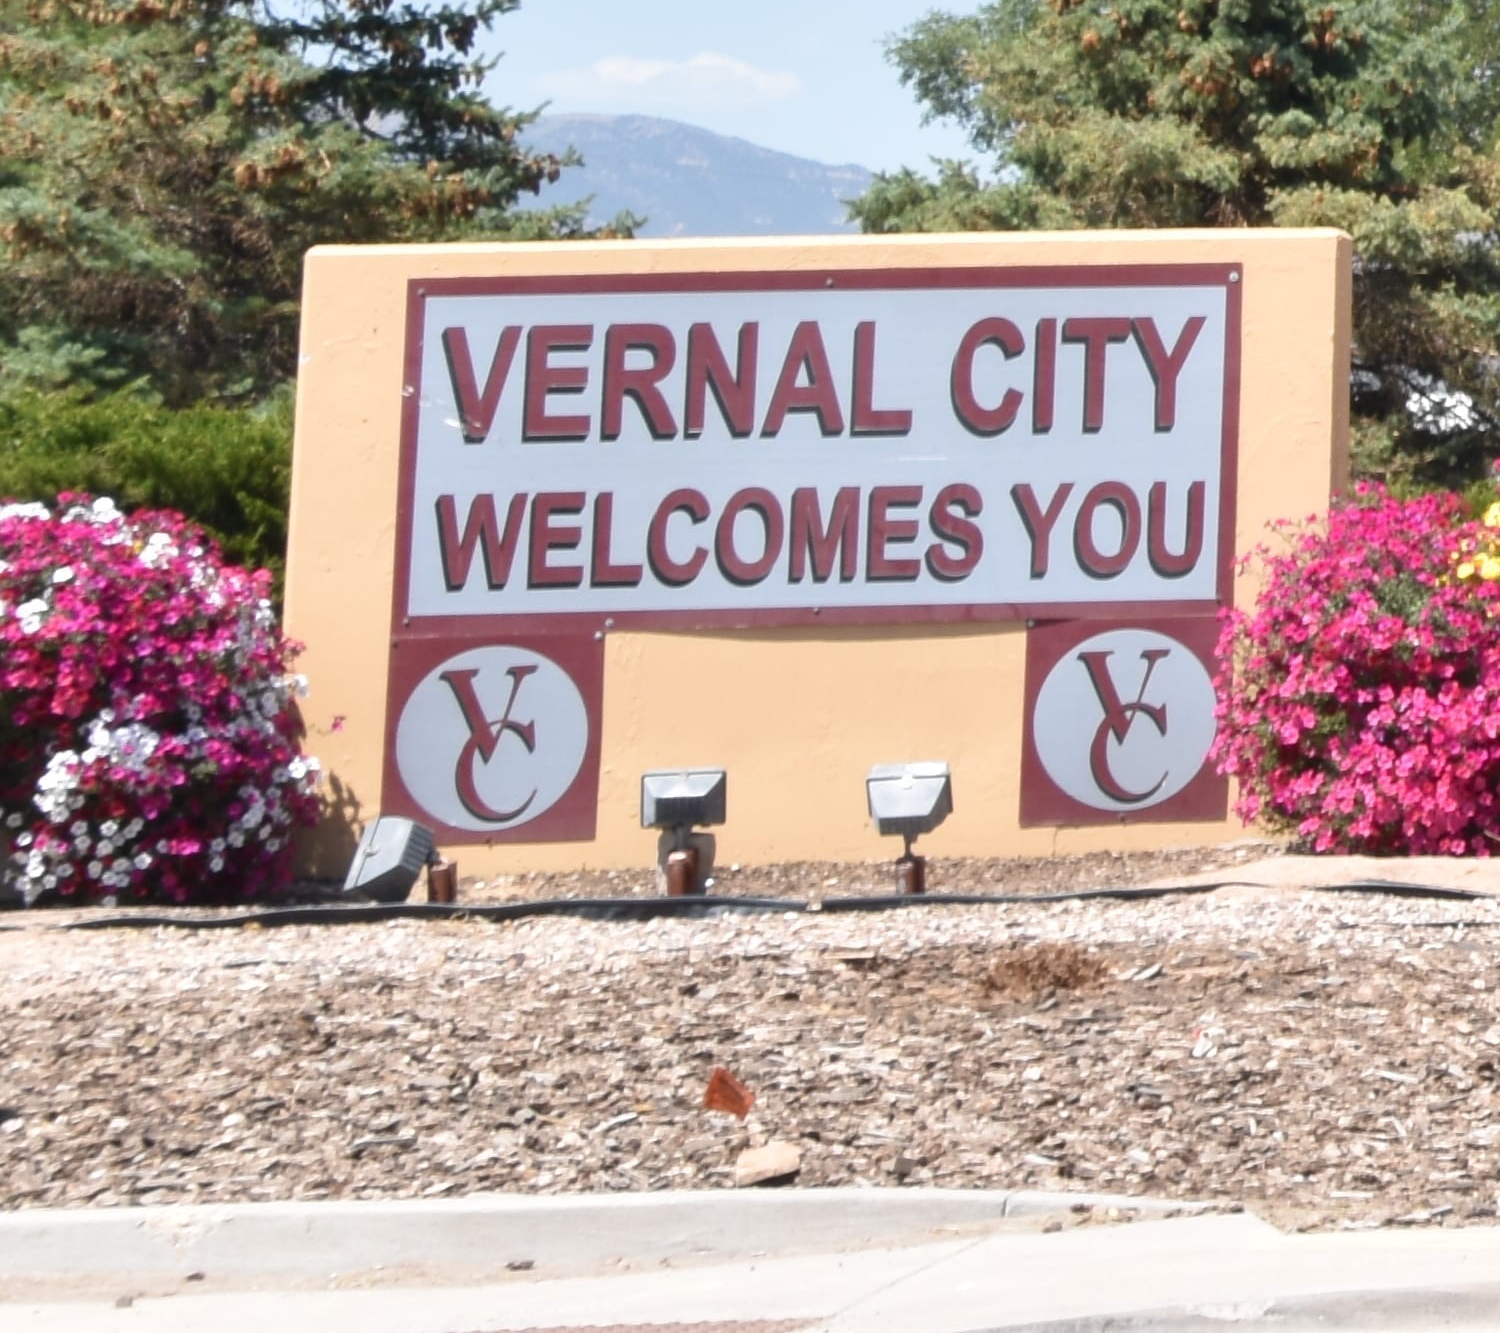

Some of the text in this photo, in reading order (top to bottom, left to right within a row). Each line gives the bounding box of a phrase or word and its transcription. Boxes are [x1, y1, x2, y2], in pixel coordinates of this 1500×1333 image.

[443, 315, 1208, 444] VERNAL CITY
[435, 479, 1207, 592] WELCOMES YOU
